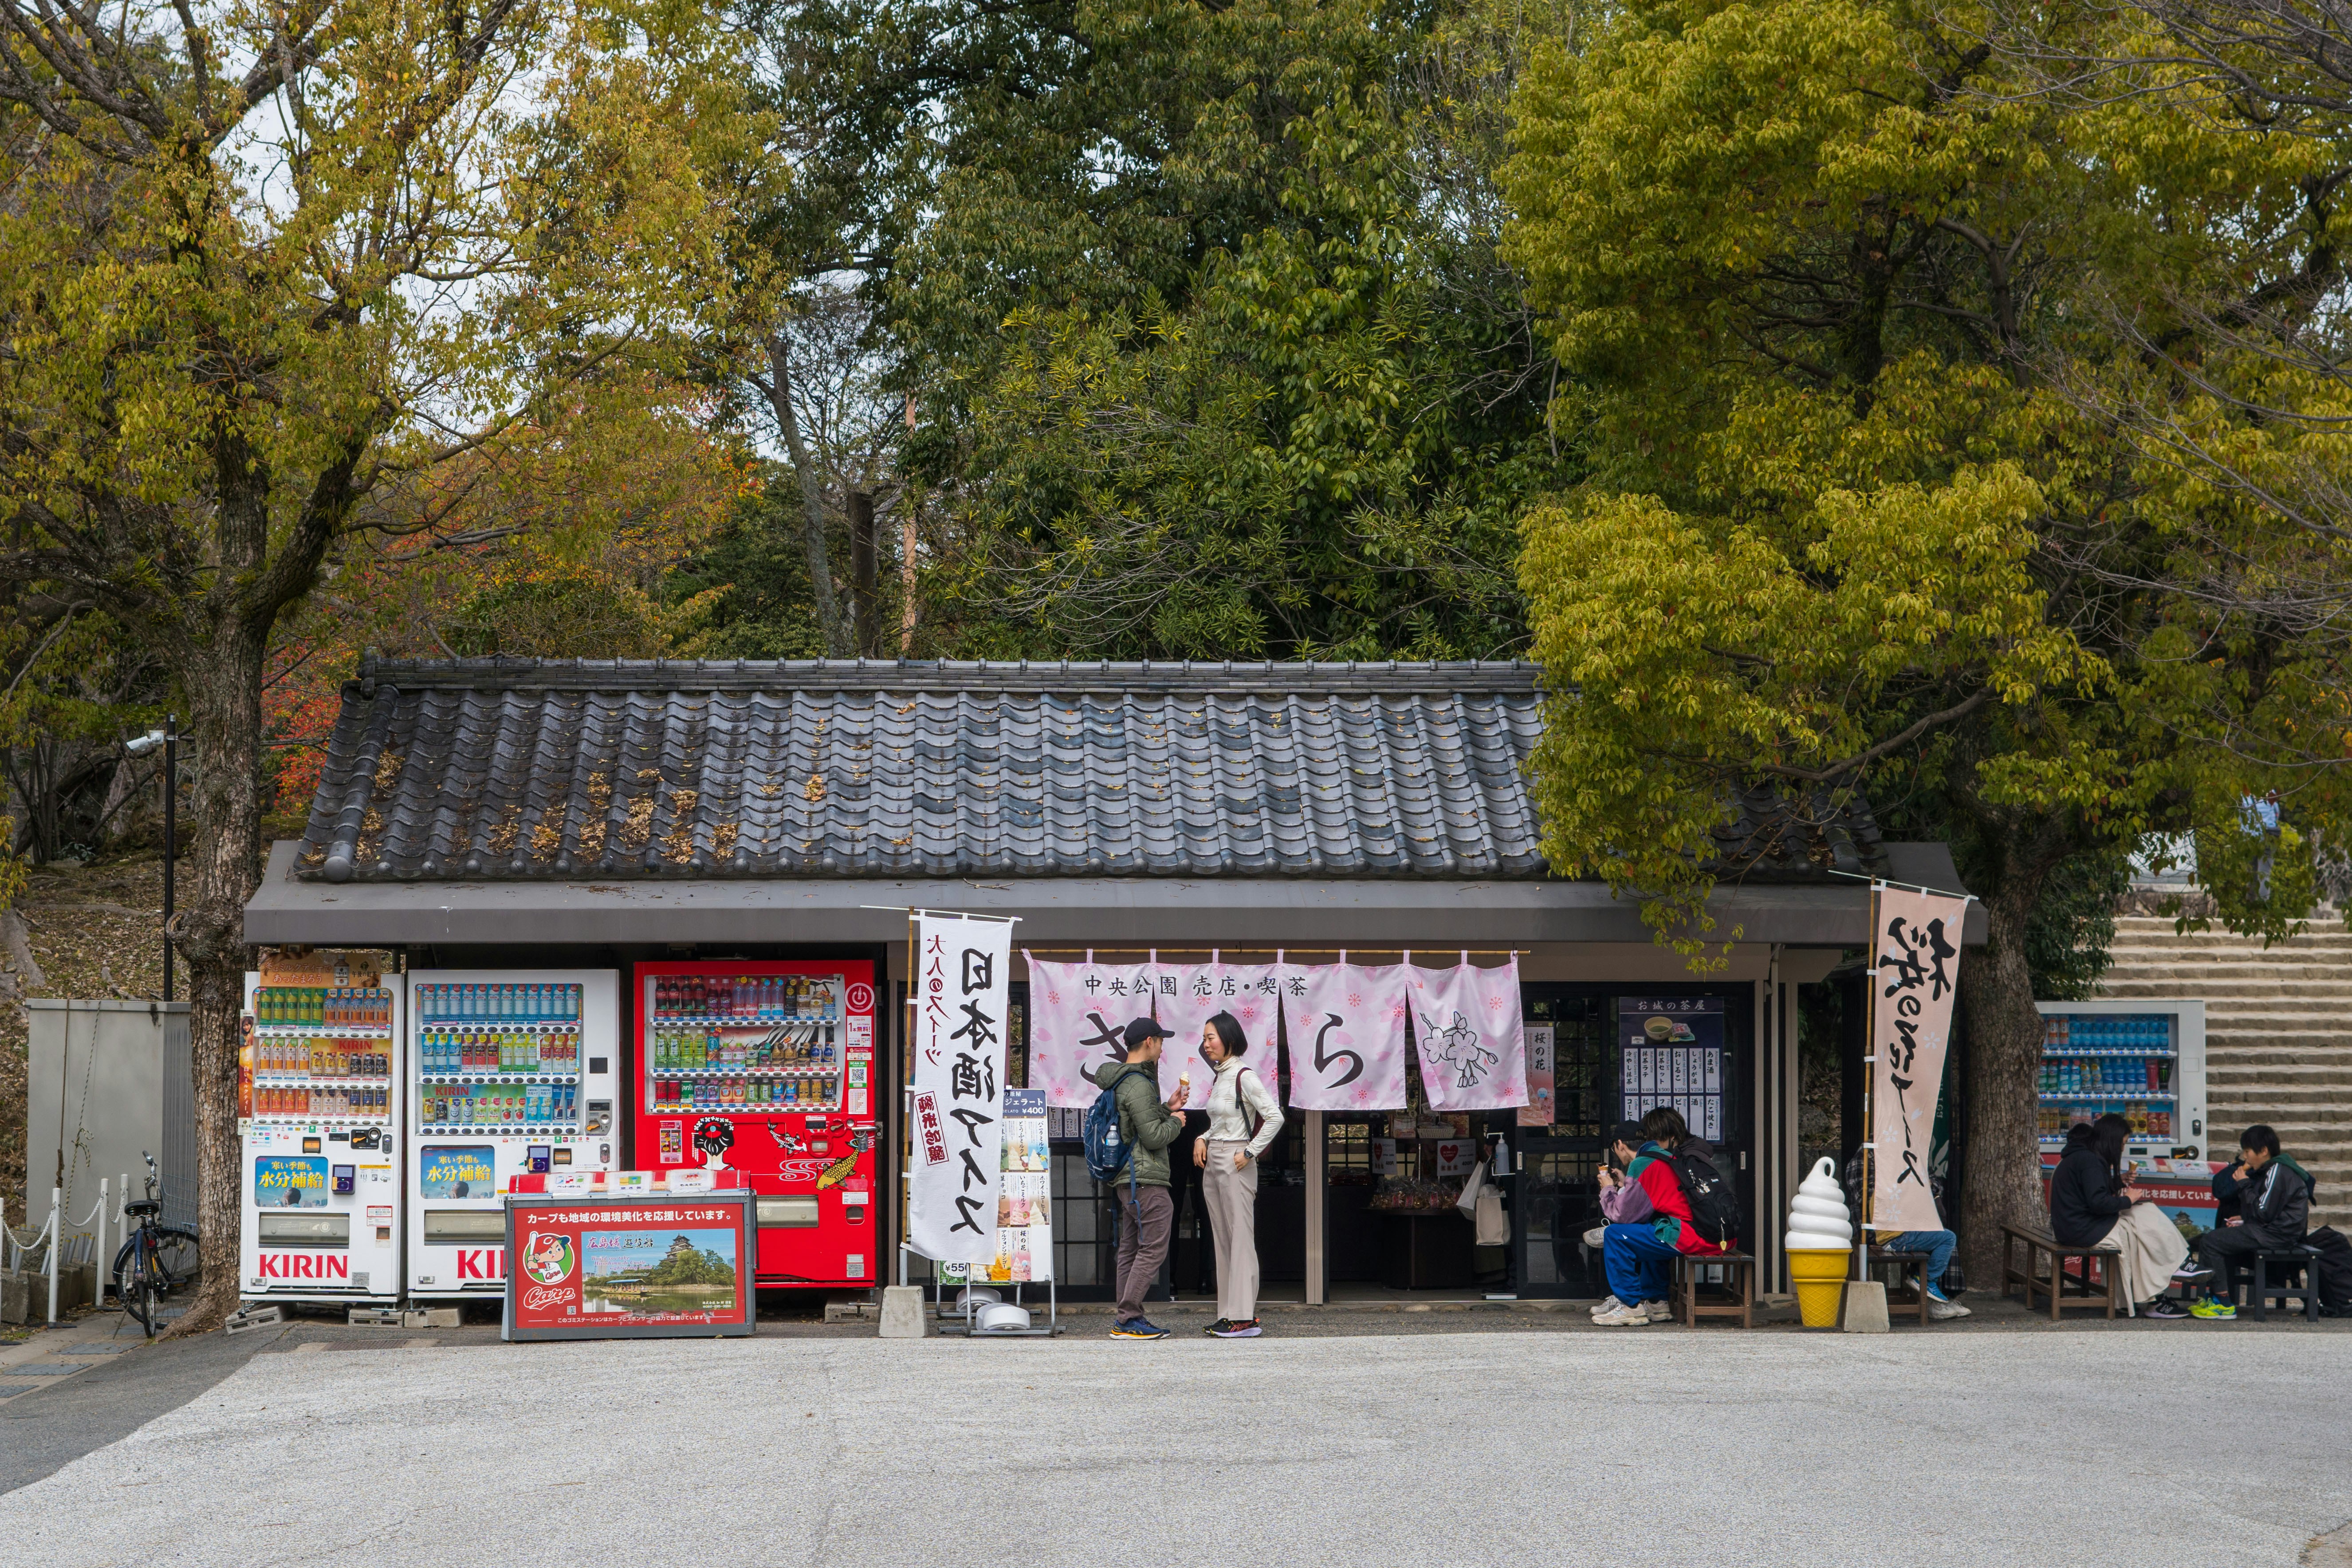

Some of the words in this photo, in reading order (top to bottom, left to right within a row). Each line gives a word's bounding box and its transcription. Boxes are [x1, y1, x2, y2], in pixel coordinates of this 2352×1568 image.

[265, 962, 331, 973] 冬はミルクティーで
[273, 973, 323, 984] あったまろう
[1085, 974, 1177, 997] 中央公園
[1638, 1000, 1705, 1010] お城の茶屋
[338, 1040, 372, 1050] KIRIN
[1535, 1032, 1546, 1070] 桜の花
[435, 1086, 469, 1096] KIRIN
[271, 1161, 312, 1171] 寒い季節も
[438, 1155, 479, 1164] 寒い季節も
[259, 1171, 324, 1188] 水分補給
[426, 1165, 491, 1182] 水分補給
[527, 1210, 731, 1224] カープも地域の環境美化を応援しています。
[586, 1236, 621, 1249] 広島城
[259, 1254, 348, 1278] KIRIN
[457, 1250, 507, 1279] KI
[945, 1263, 967, 1272] ¥55
[523, 1286, 575, 1310] Carp
